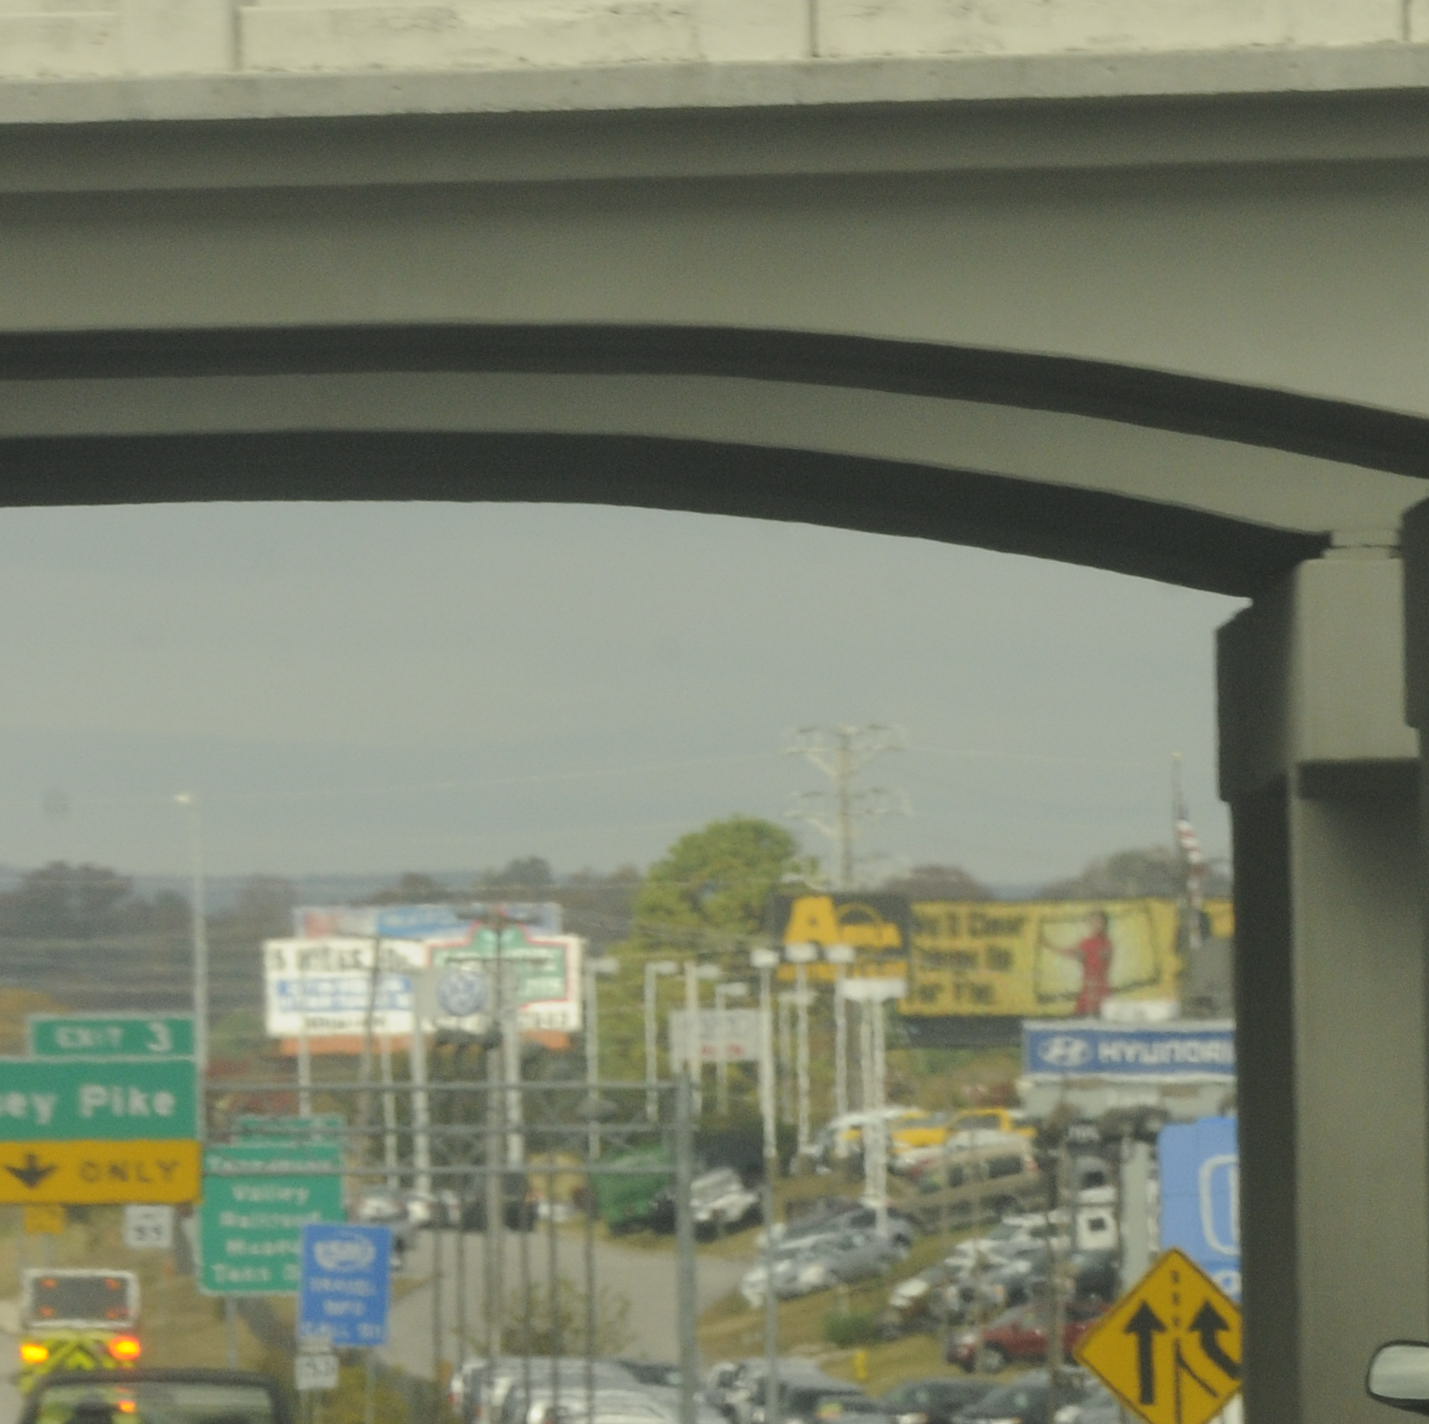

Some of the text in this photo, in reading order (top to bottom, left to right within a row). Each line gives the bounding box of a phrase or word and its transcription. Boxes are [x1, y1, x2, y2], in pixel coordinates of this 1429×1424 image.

[56, 1021, 172, 1052] EXIT 3
[79, 1084, 176, 1118] Pike
[80, 1160, 181, 1183] ONLY
[232, 1184, 310, 1206] Valley
